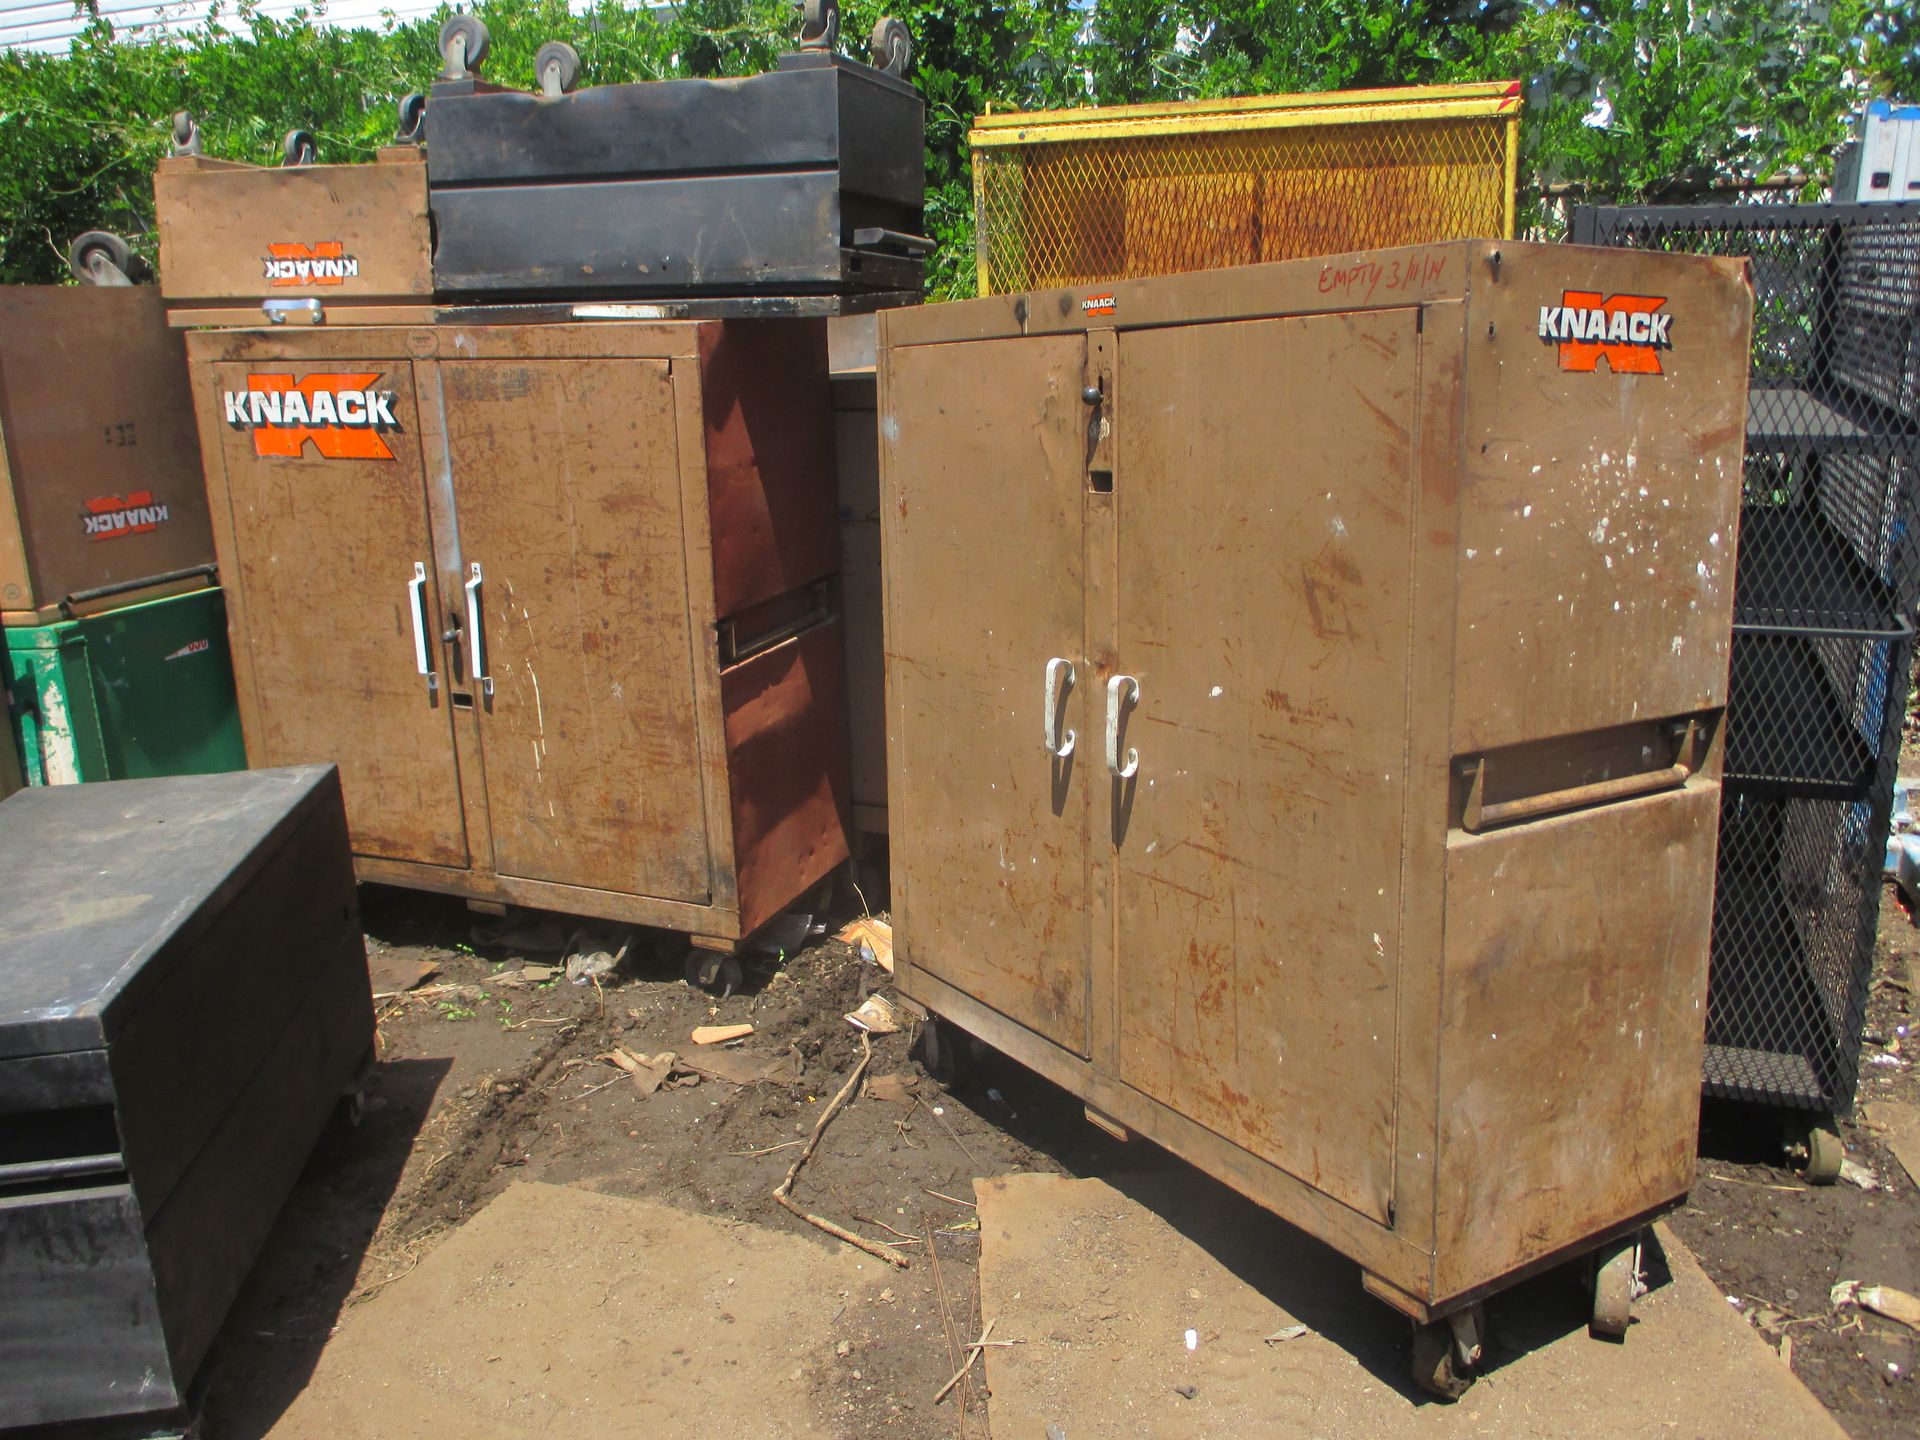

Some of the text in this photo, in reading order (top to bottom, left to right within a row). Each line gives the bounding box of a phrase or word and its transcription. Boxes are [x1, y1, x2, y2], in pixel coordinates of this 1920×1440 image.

[264, 258, 359, 278] KNAACK
[1318, 260, 1384, 304] EMPTY
[1081, 296, 1116, 310] KNAACK
[1538, 305, 1673, 345] KNAACK
[224, 389, 397, 425] KNAACK
[83, 504, 169, 534] KNAACK
